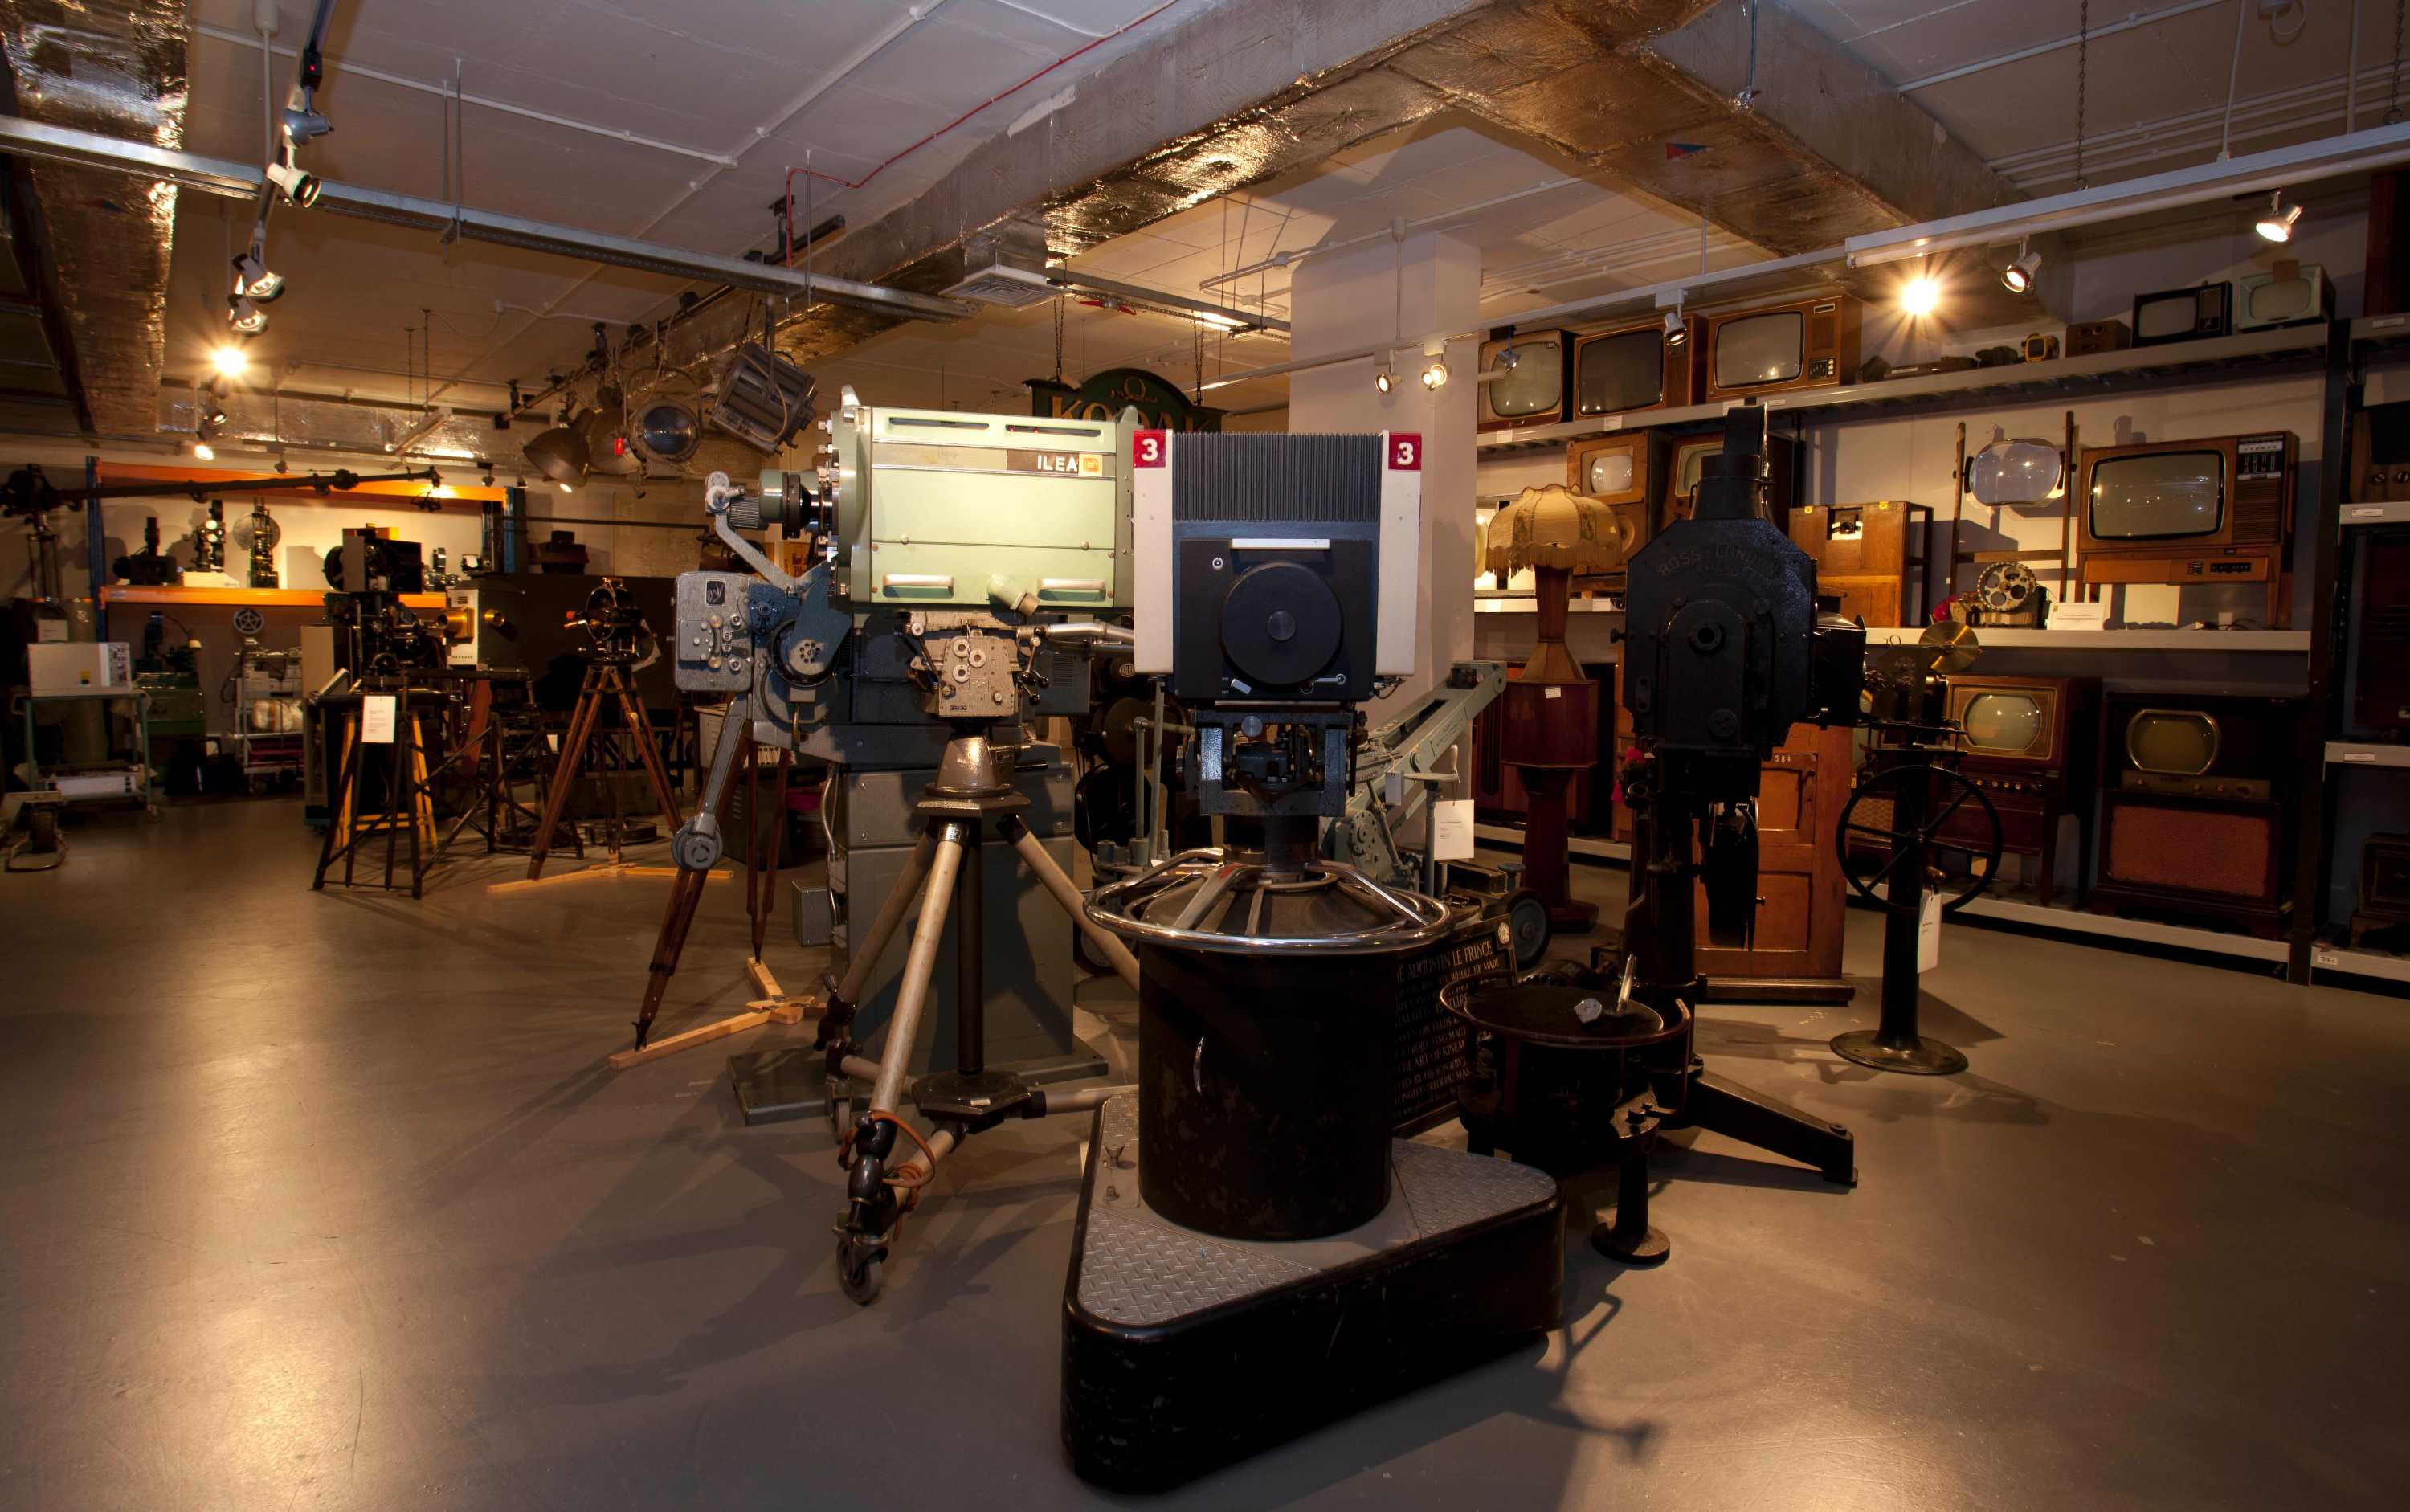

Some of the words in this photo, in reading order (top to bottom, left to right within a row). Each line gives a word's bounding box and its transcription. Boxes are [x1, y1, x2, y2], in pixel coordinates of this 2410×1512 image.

[1141, 438, 1158, 462] 3
[1397, 442, 1414, 466] 3
[1037, 455, 1077, 472] ILEA
[1452, 950, 1463, 966] LE
[1464, 939, 1493, 963] PRINCE
[1441, 1039, 1466, 1056] KINEM
